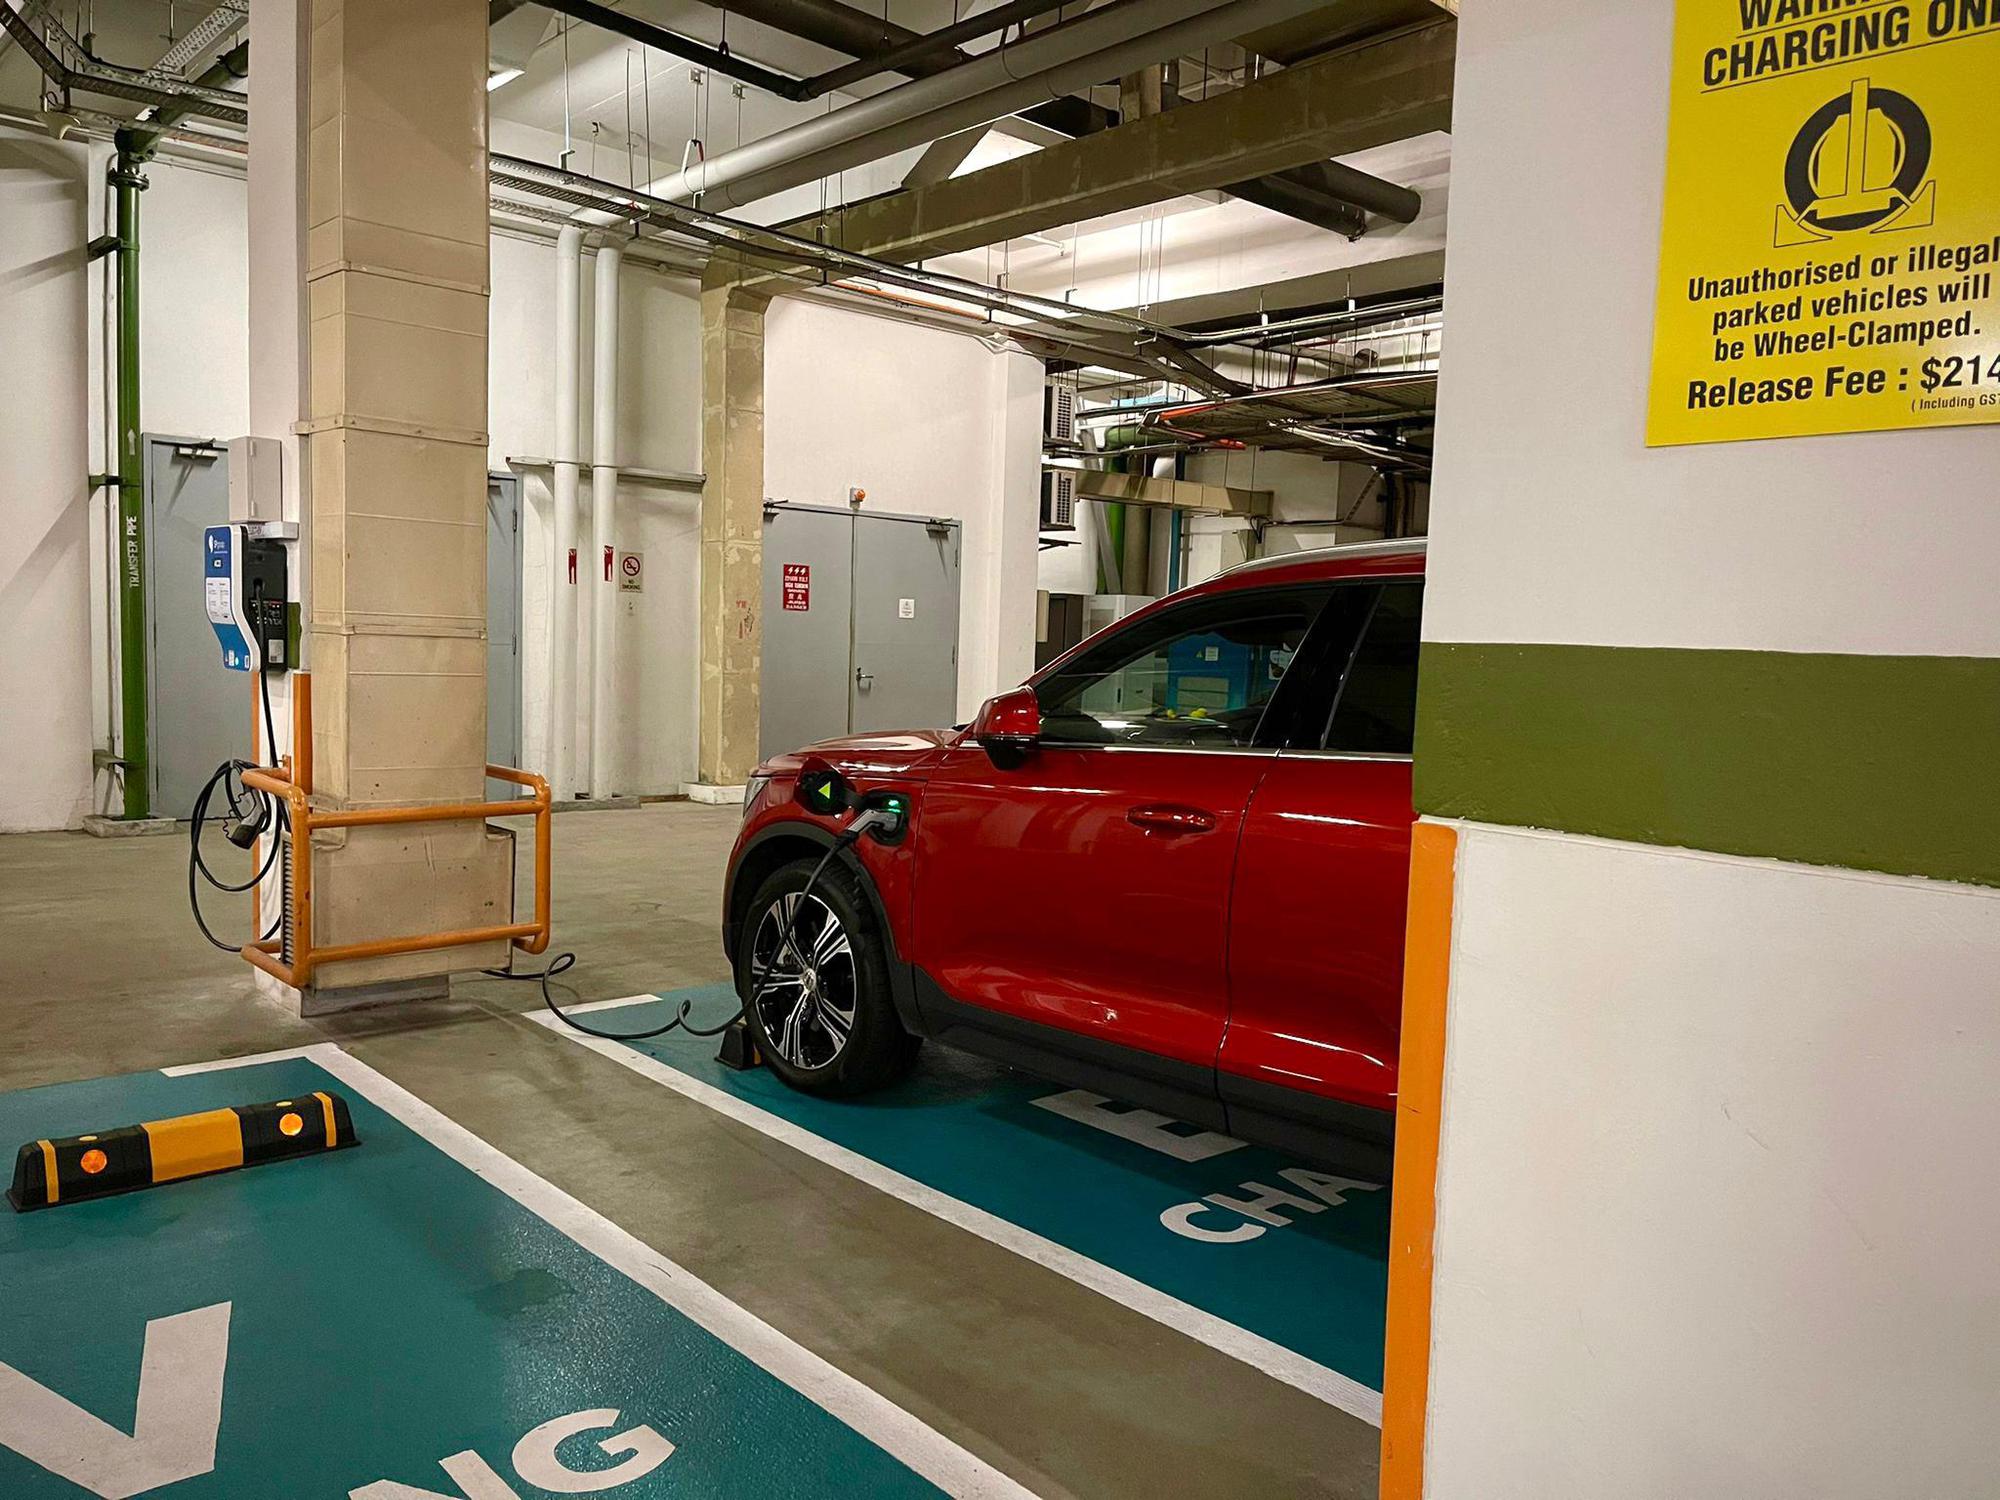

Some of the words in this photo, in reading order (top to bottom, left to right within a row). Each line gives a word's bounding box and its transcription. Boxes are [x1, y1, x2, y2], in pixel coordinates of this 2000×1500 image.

[1703, 6, 1910, 86] CHARGING
[1688, 254, 1861, 301] Unauthorised
[1871, 255, 1898, 277] or
[1908, 236, 2000, 272] illegal
[1713, 296, 1802, 335] parked
[1811, 284, 1928, 317] vehicles
[1938, 273, 1990, 303] will
[1714, 338, 1744, 362] be
[1754, 310, 1980, 357] Wheel-Clamped.
[1688, 376, 1813, 409] Release
[1825, 366, 1886, 397] Fee
[1919, 396, 1975, 409] Including
[126, 515, 137, 536] PIPE
[127, 540, 140, 588] TRANSFER
[1160, 1168, 1385, 1243] CHA
